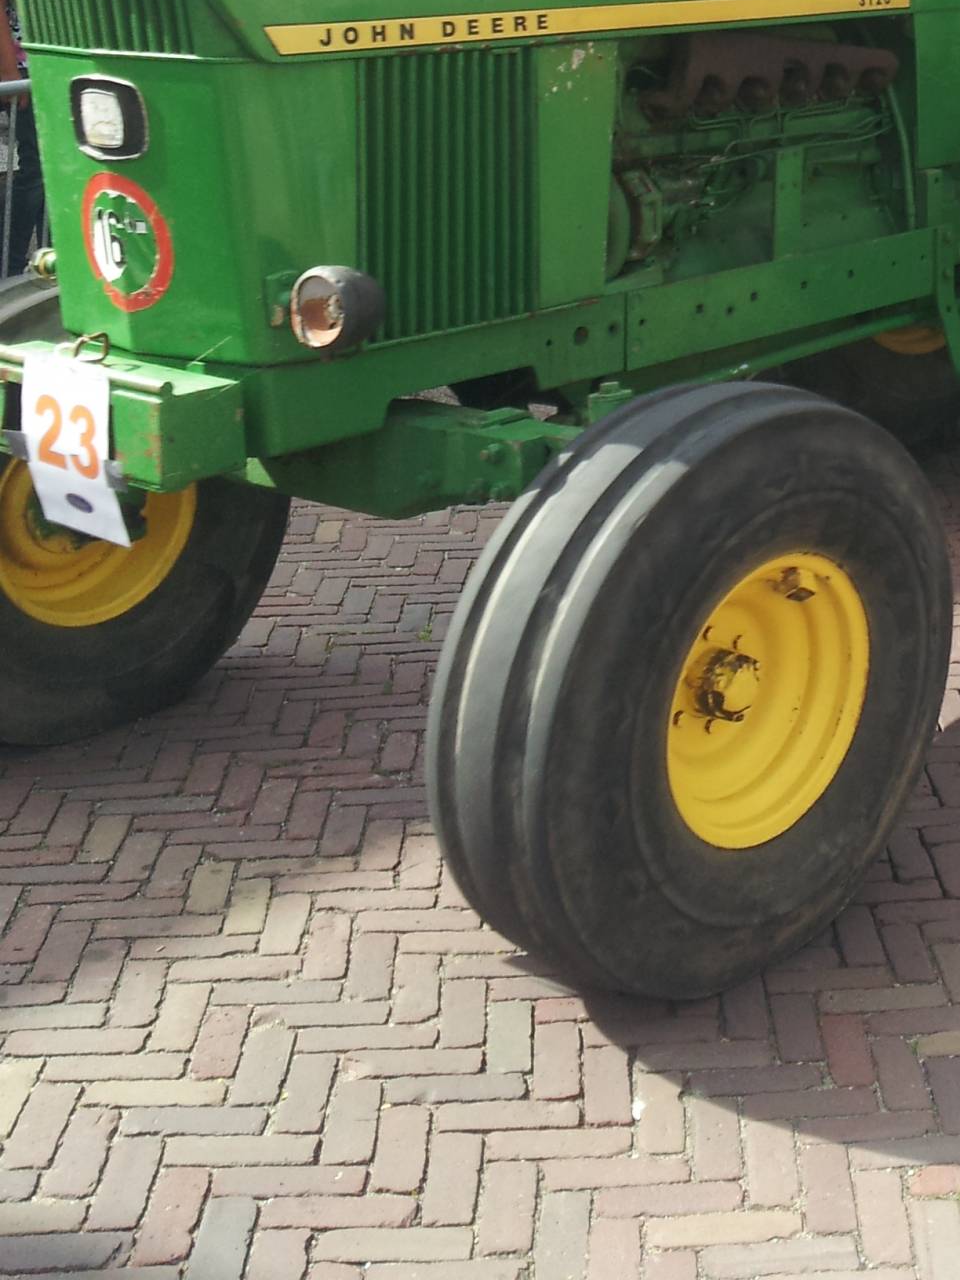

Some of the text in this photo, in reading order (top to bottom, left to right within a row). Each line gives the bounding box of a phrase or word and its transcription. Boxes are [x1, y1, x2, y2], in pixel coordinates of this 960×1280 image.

[320, 14, 549, 46] JOHN DEERE
[35, 393, 100, 481] 23
